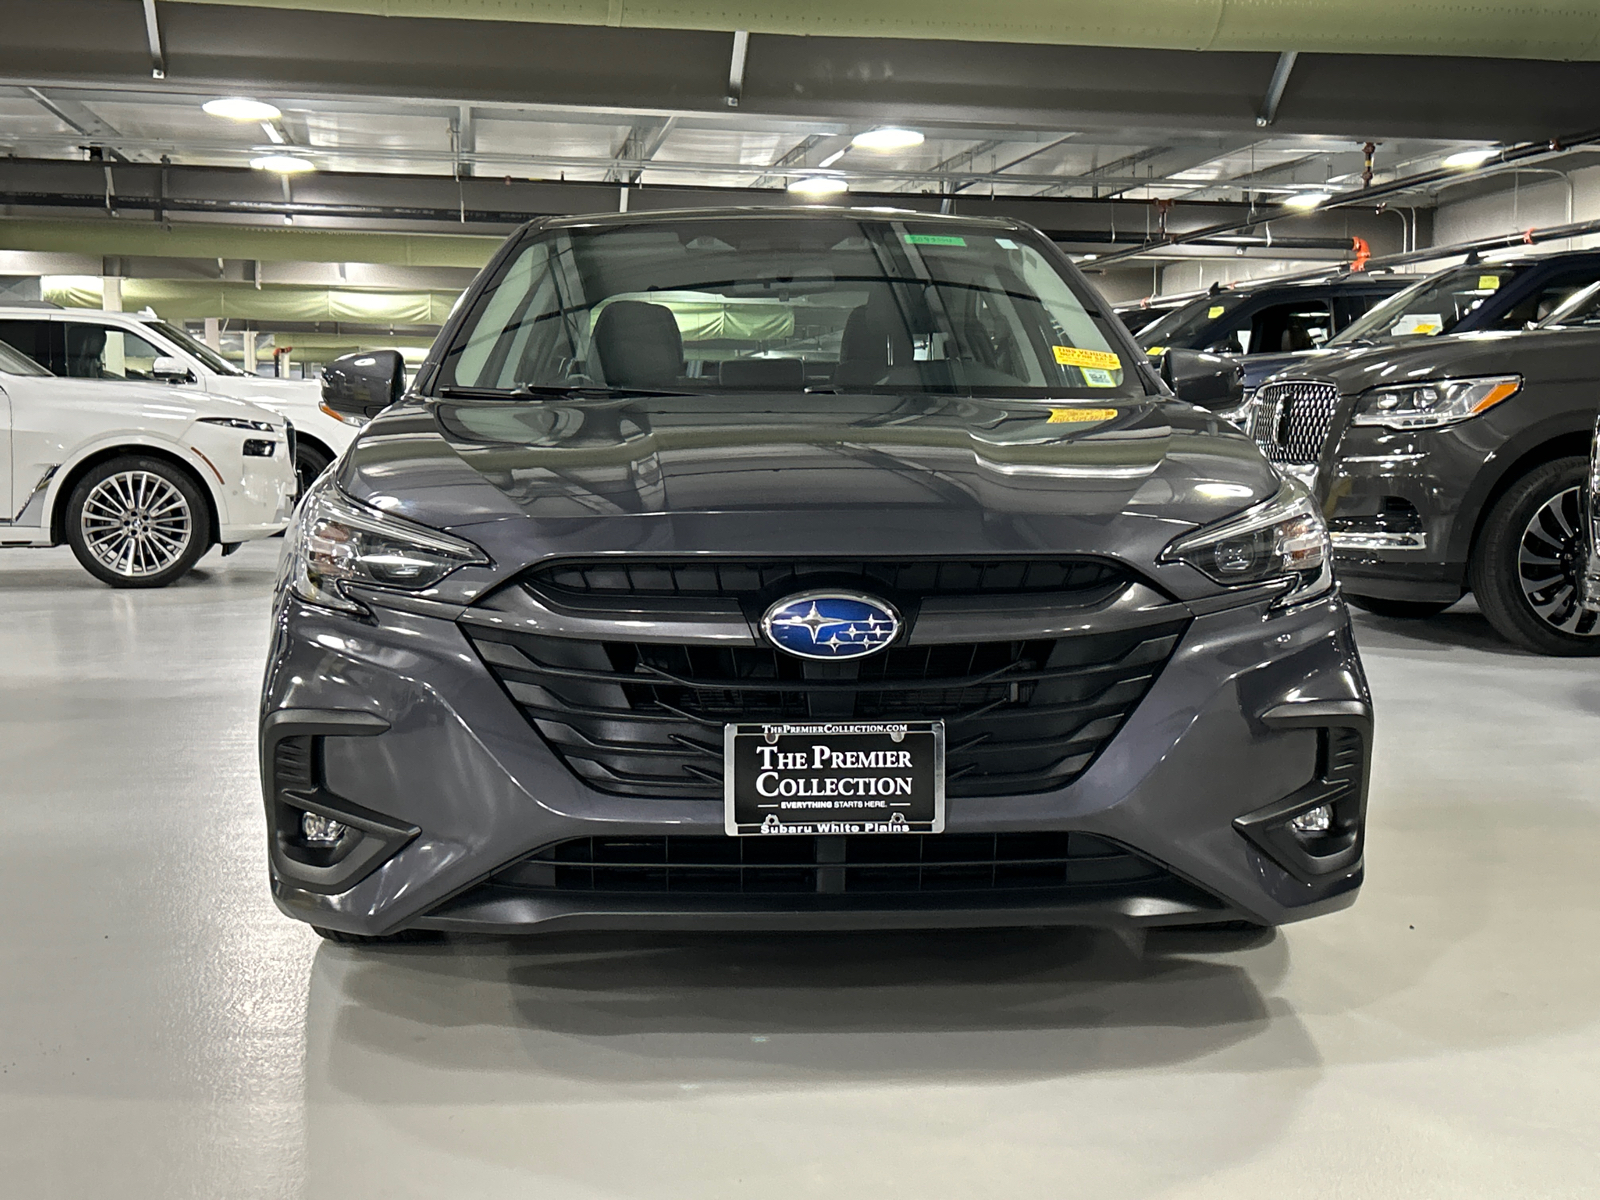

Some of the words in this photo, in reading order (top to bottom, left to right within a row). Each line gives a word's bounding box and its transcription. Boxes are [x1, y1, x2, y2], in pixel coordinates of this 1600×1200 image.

[756, 745, 808, 770] THE
[811, 745, 913, 769] PREMIER
[755, 771, 913, 797] COLLECTION
[780, 801, 833, 809] EVERYTHING
[834, 800, 863, 809] STARTS
[864, 800, 888, 808] HERE.
[760, 823, 813, 834] Subaru
[817, 823, 860, 834] White
[865, 822, 910, 833] Plains
